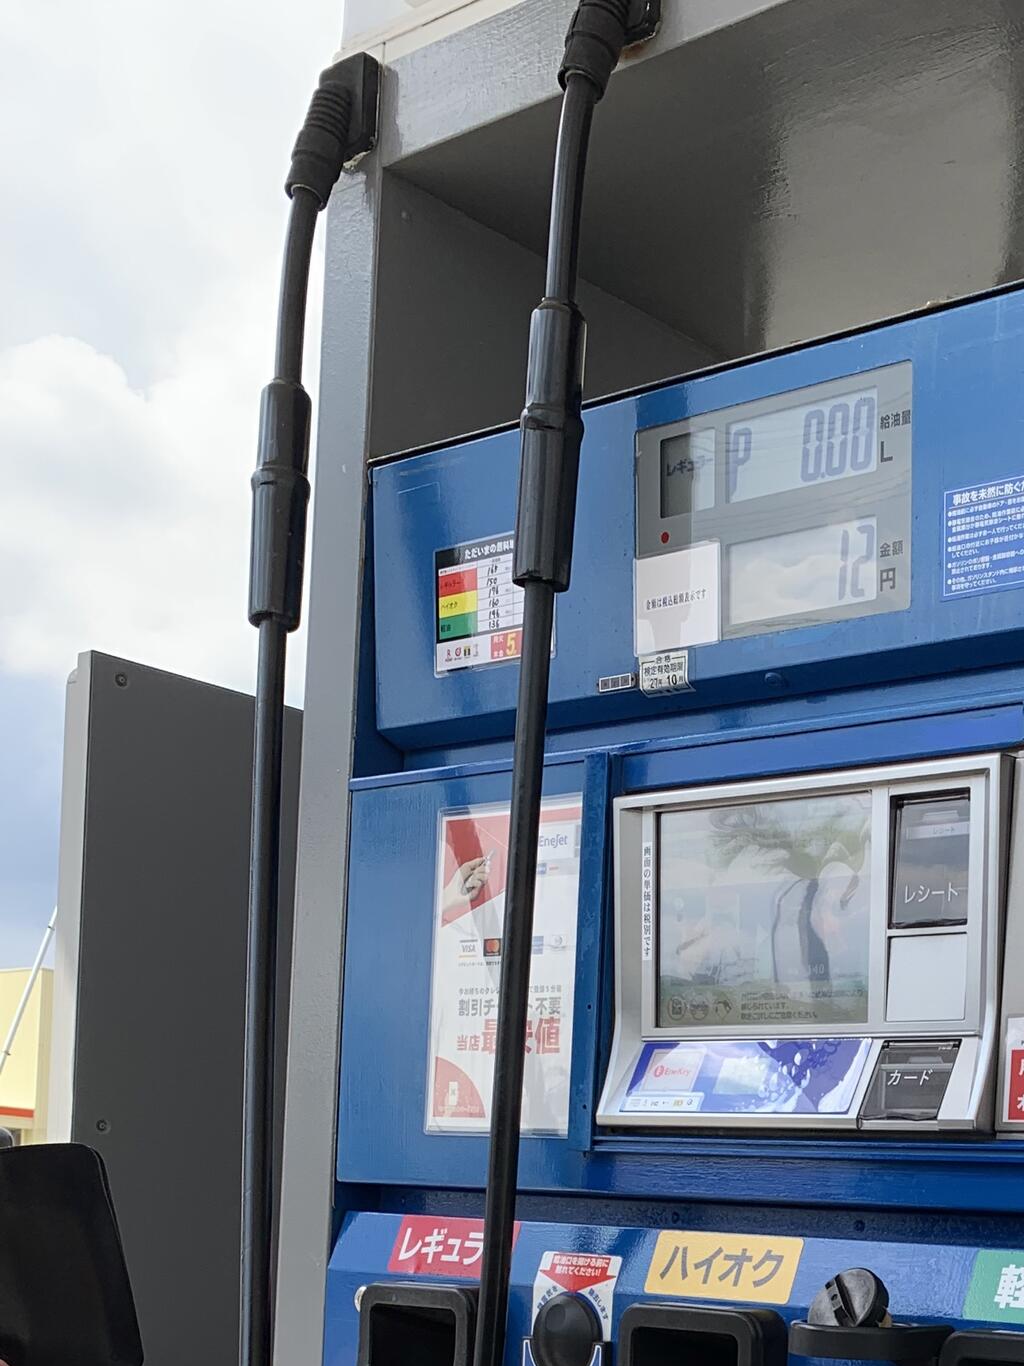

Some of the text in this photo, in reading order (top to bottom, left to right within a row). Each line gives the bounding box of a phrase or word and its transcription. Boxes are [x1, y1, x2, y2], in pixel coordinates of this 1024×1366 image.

[880, 409, 911, 430] 給油量
[801, 396, 875, 483] 0.00
[880, 440, 893, 464] L
[667, 454, 713, 477] レギュラー
[880, 540, 903, 558] 金額
[838, 524, 875, 601] 12
[879, 567, 896, 592] 円
[904, 881, 959, 903] レシート
[887, 1068, 934, 1087] カード
[397, 1227, 484, 1265] レギュラ
[659, 1245, 785, 1288] ハイオク
